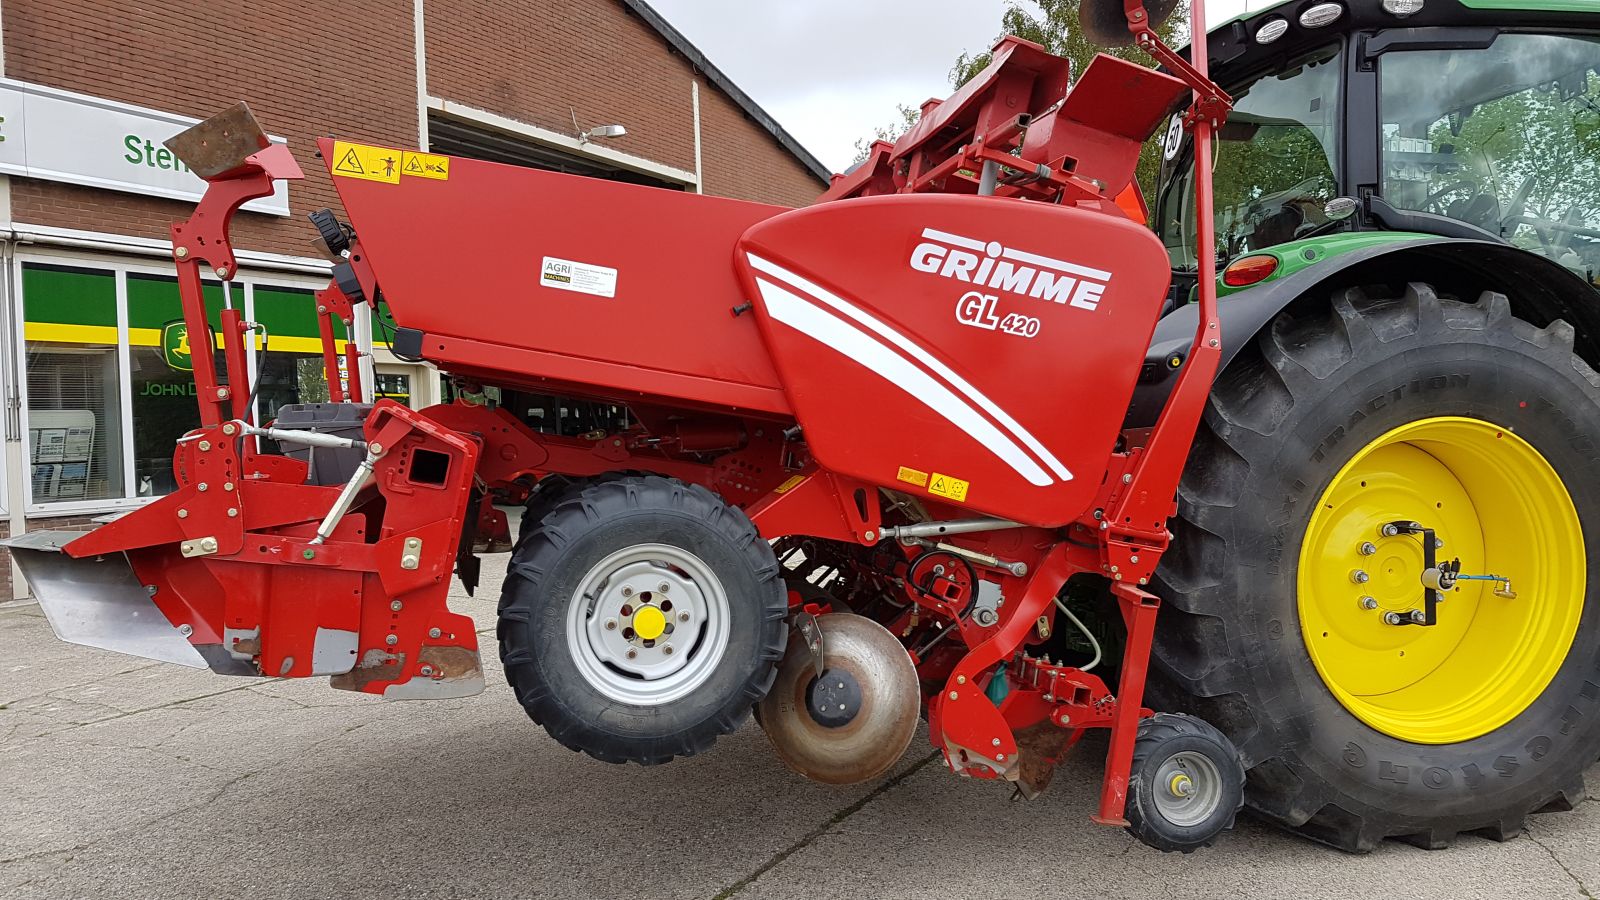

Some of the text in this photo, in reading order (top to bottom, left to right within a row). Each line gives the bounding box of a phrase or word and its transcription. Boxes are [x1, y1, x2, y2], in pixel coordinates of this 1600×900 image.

[546, 262, 571, 273] AGRI
[910, 241, 1106, 311] GRIMME
[955, 291, 1040, 338] GL 420
[140, 381, 185, 396] JOHN
